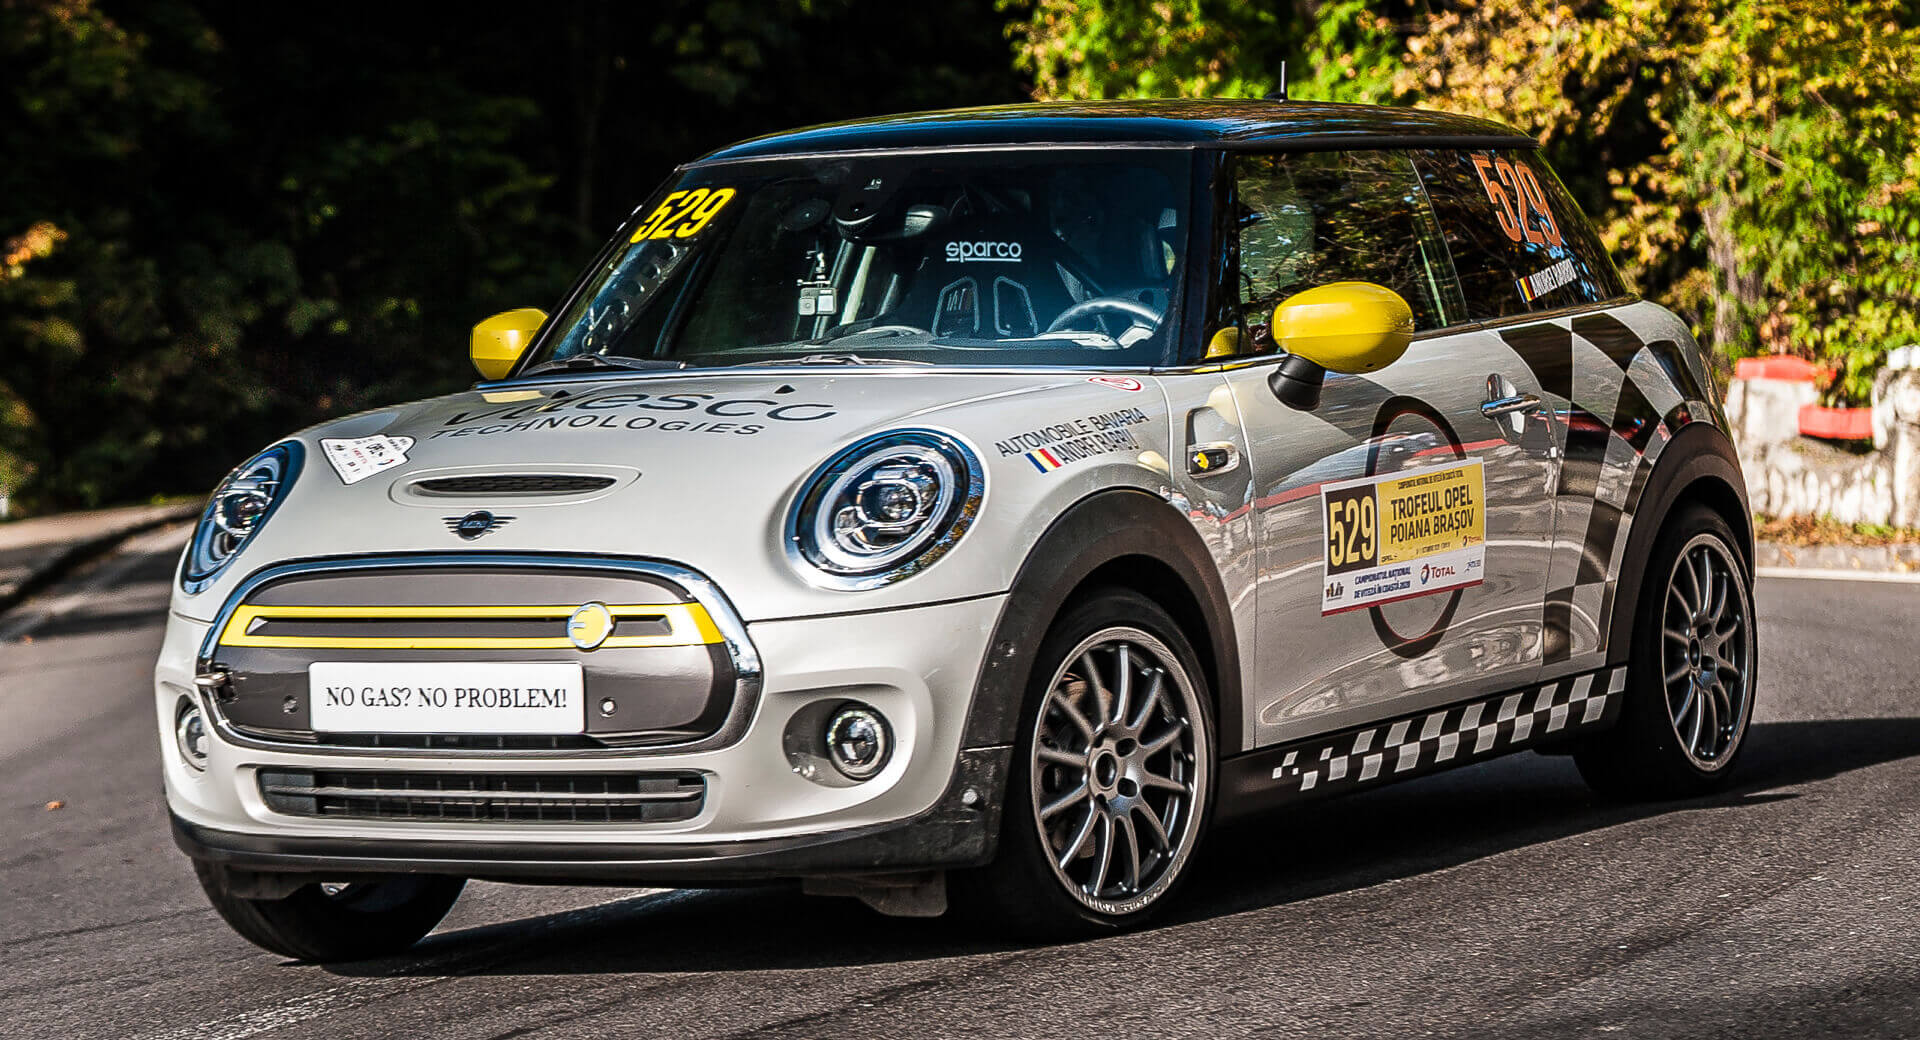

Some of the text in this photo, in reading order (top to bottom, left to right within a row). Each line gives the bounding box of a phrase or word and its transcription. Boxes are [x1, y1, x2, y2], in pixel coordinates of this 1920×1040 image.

[630, 187, 737, 243] 529
[1470, 153, 1562, 247] 529
[945, 240, 1022, 263] sparco
[429, 415, 765, 440] TECHNOLOGIES
[995, 407, 1150, 457] AUTOMOBILE BAVARIA
[1051, 434, 1105, 464] ANDREI
[1391, 484, 1473, 521] TROFEUL OPEL
[1329, 495, 1376, 567] 529
[1390, 518, 1431, 544] POIANA
[1430, 565, 1456, 579] TOTAL
[325, 686, 567, 708] NO GAS? NO PROBLEM!
